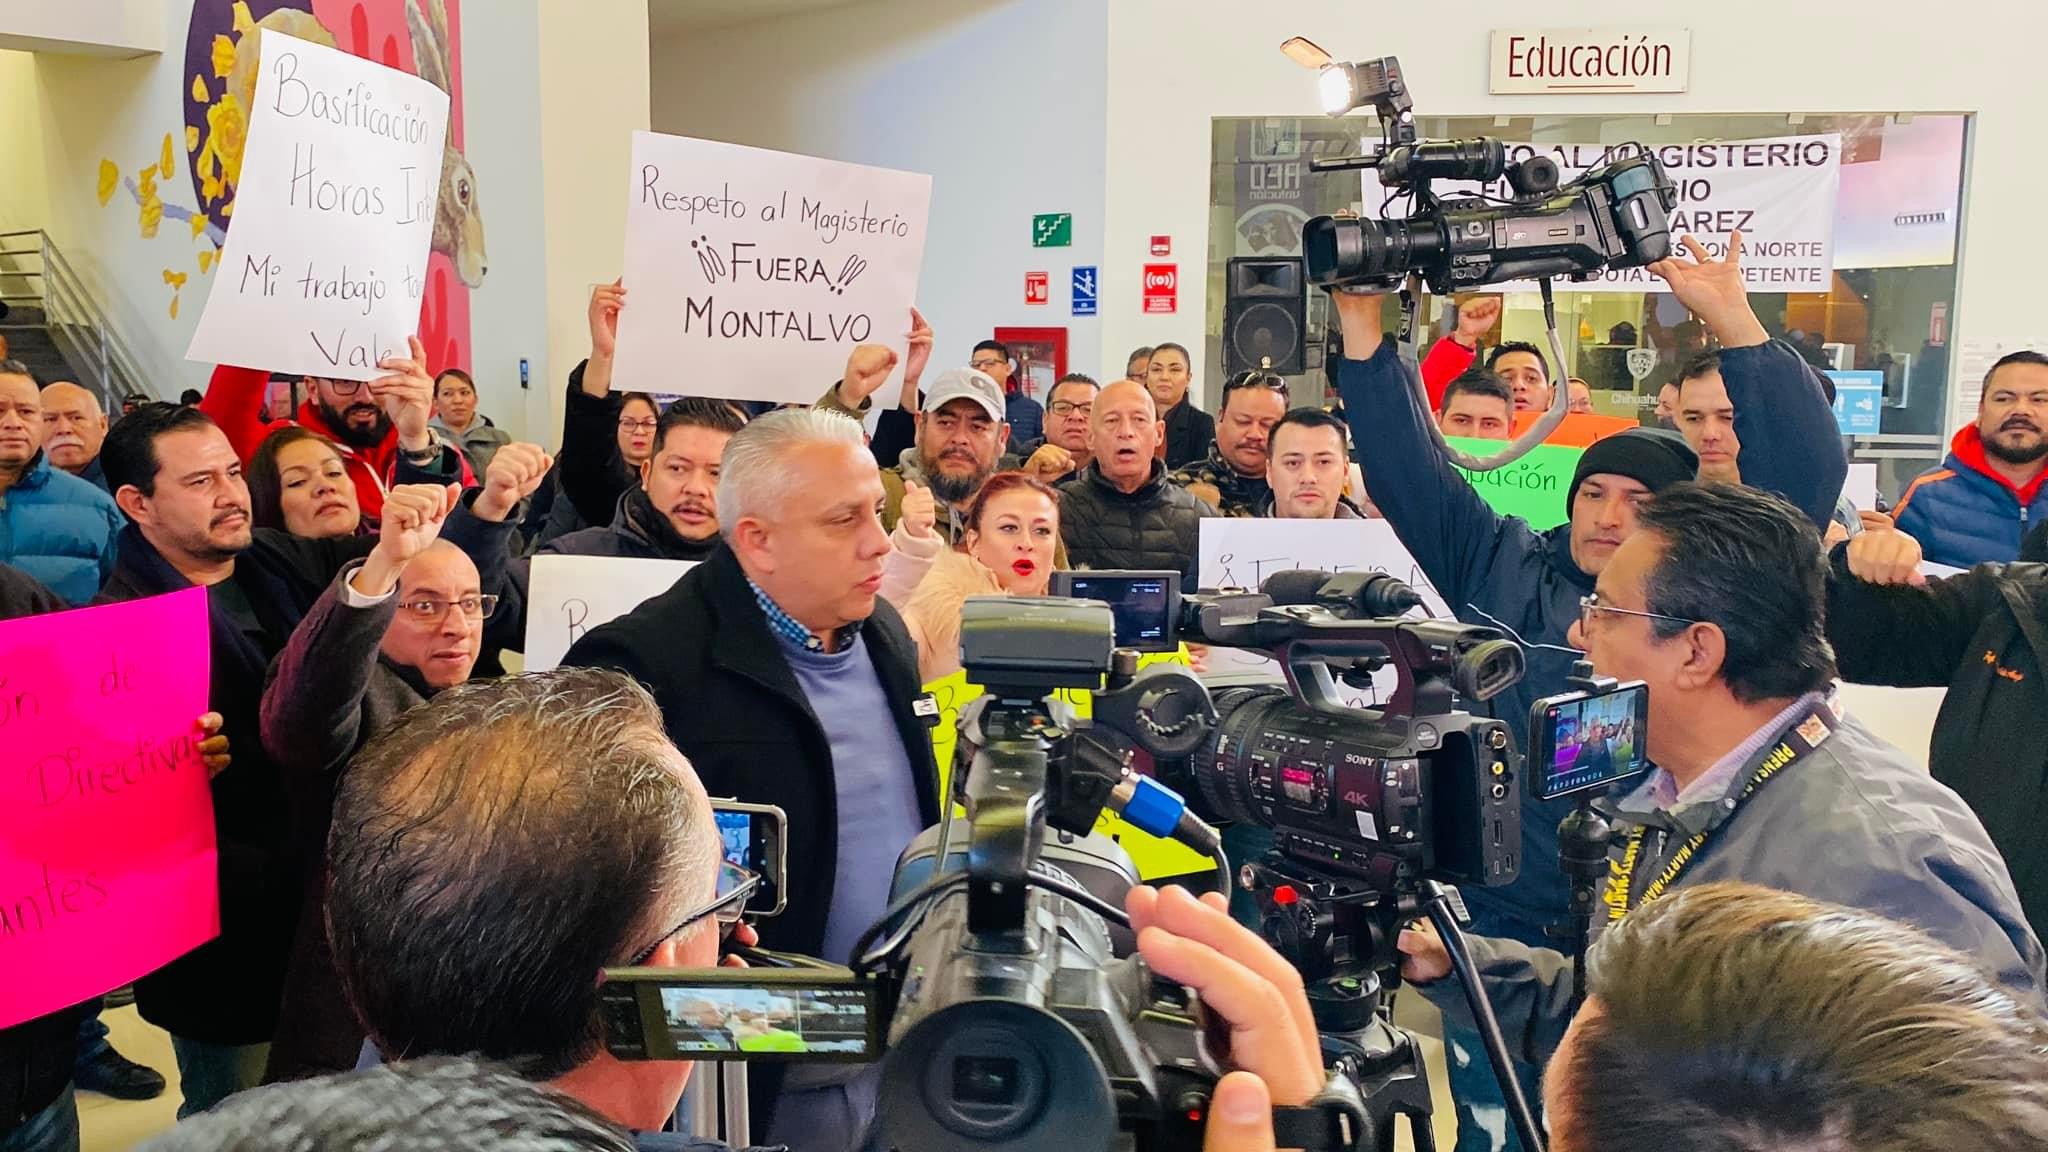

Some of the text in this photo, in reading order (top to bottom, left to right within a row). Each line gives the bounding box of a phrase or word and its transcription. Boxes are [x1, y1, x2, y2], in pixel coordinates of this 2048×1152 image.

[1508, 35, 1671, 78] Educación
[290, 143, 385, 216] Horas
[642, 164, 909, 244] Respeto al Magisterio
[1755, 242, 1824, 258] NORTE
[239, 254, 281, 298] Mi
[298, 261, 386, 316] trabajo
[684, 295, 872, 343] MONTALVO
[1611, 393, 1659, 405] Chihuahu
[1344, 753, 1375, 767] SONY
[1343, 791, 1370, 807] 4K
